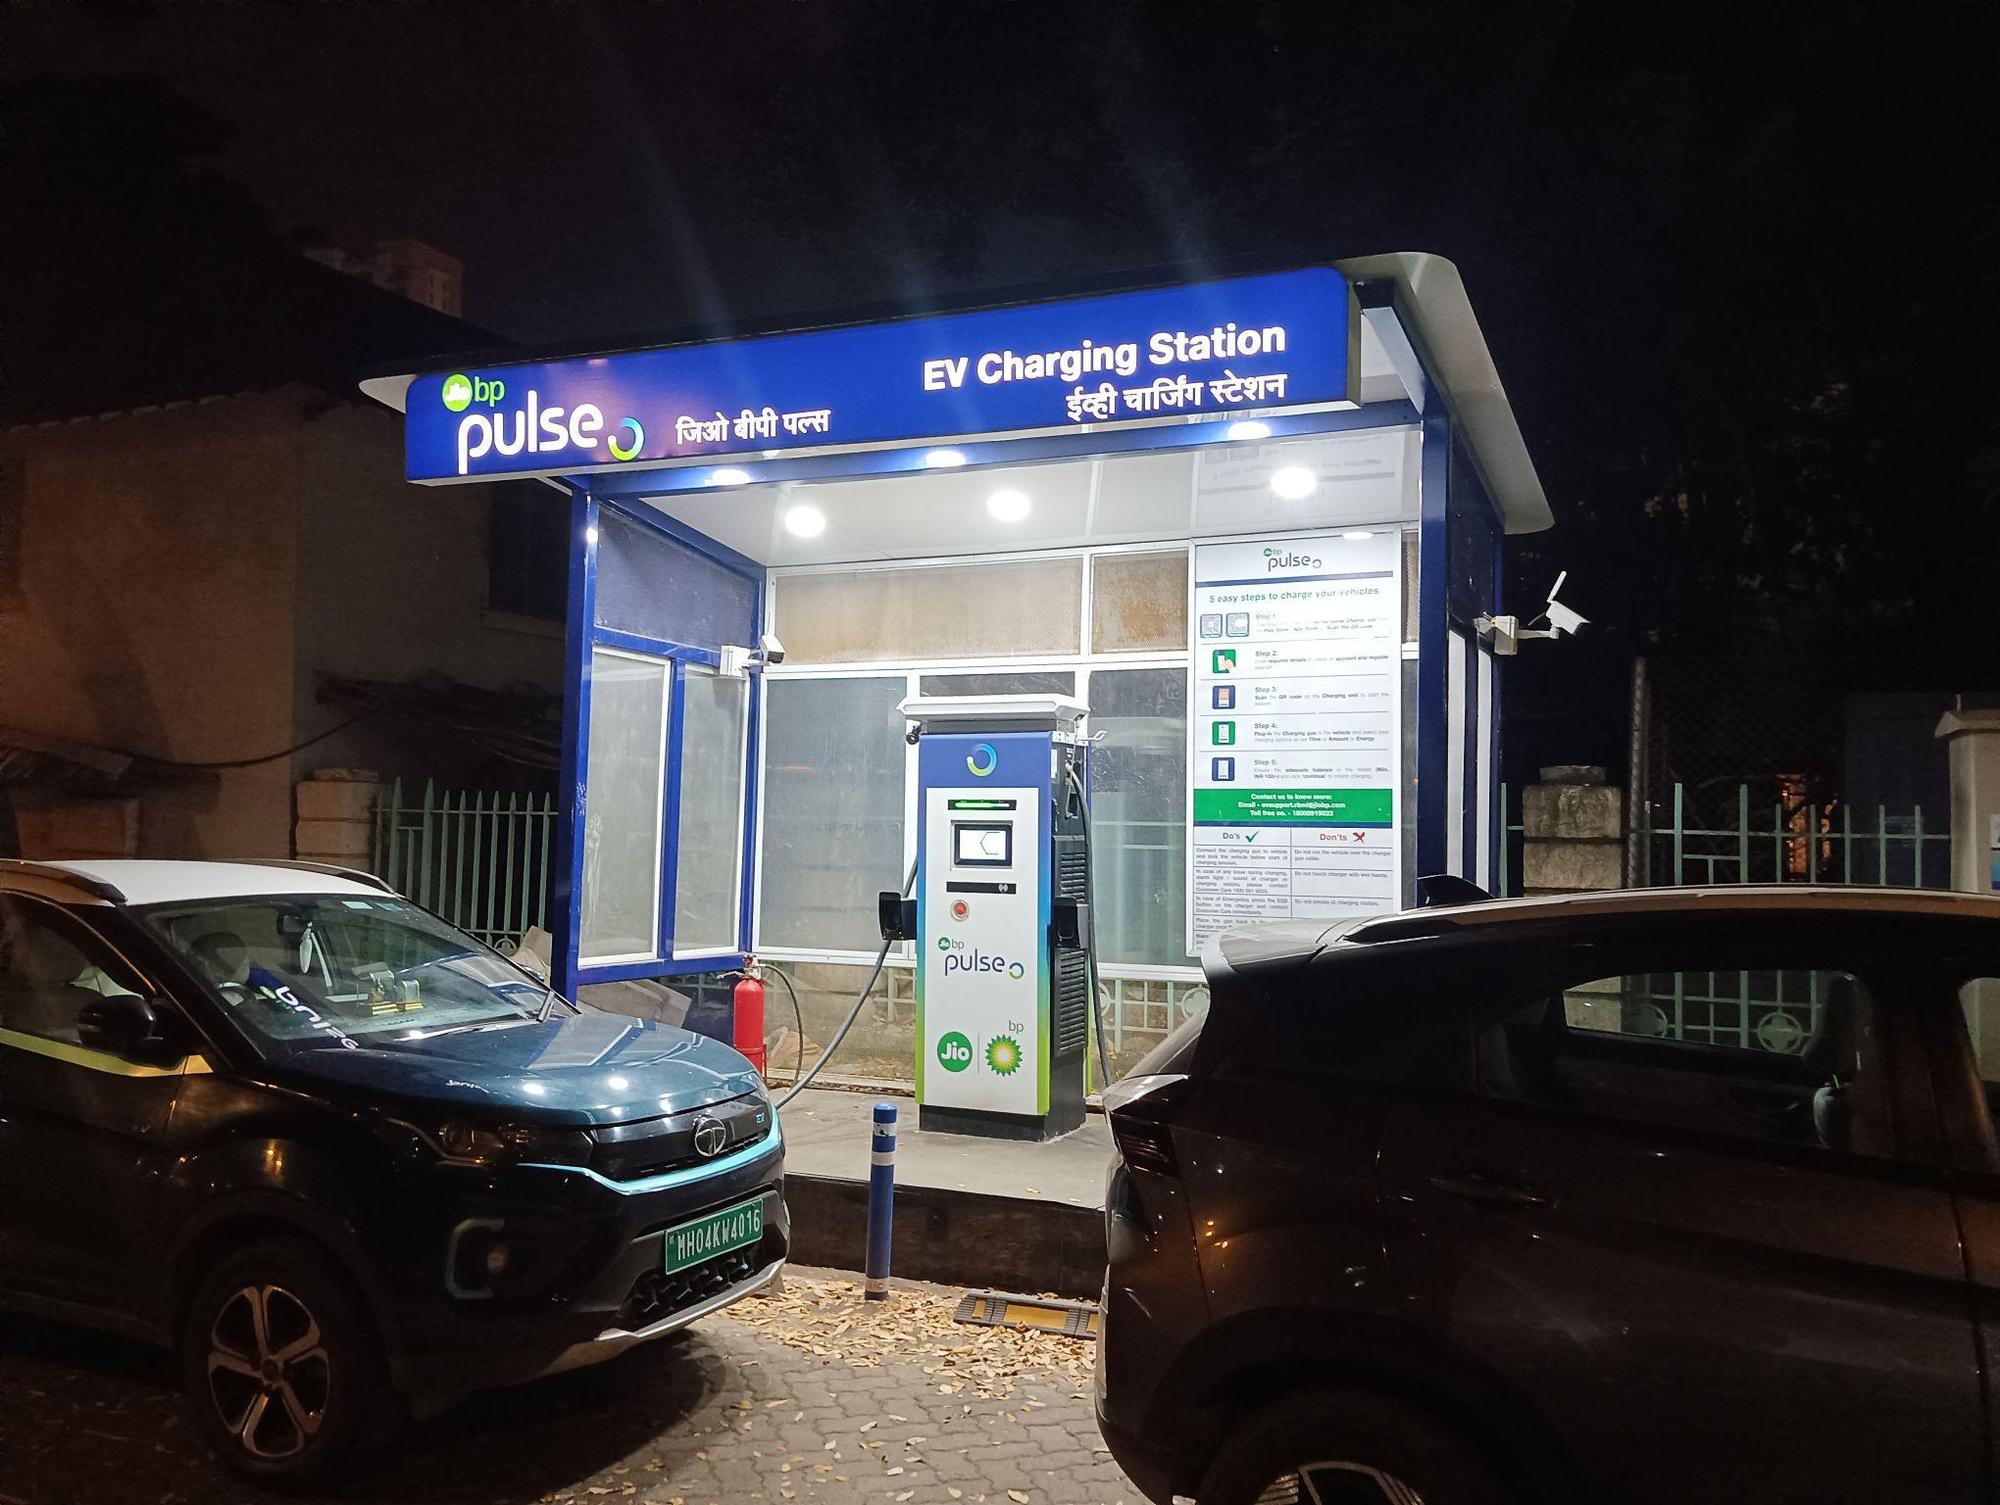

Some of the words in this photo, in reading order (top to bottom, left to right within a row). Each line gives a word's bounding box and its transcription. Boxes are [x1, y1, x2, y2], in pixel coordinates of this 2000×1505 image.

[924, 357, 968, 391] EV
[977, 340, 1137, 384] Charging
[1149, 322, 1286, 365] Station
[475, 376, 506, 407] bp
[1209, 369, 1287, 404] स्टेशन
[458, 390, 603, 474] pulse
[676, 411, 729, 445] जिओ
[734, 407, 779, 440] बीपी
[782, 409, 831, 435] पल्स
[1268, 552, 1311, 572] pulse
[1209, 595, 1214, 603] 5
[1217, 595, 1238, 604] easy
[1241, 594, 1266, 602] steps
[1281, 592, 1312, 600] charge
[1316, 591, 1336, 599] your
[1340, 588, 1379, 596] vehicles
[1222, 832, 1241, 840] Do's
[1319, 833, 1347, 841] Don'ts
[951, 938, 965, 951] bp
[944, 948, 1006, 976] pulse
[1008, 1020, 1024, 1034] bp
[941, 1041, 970, 1061] Jio
